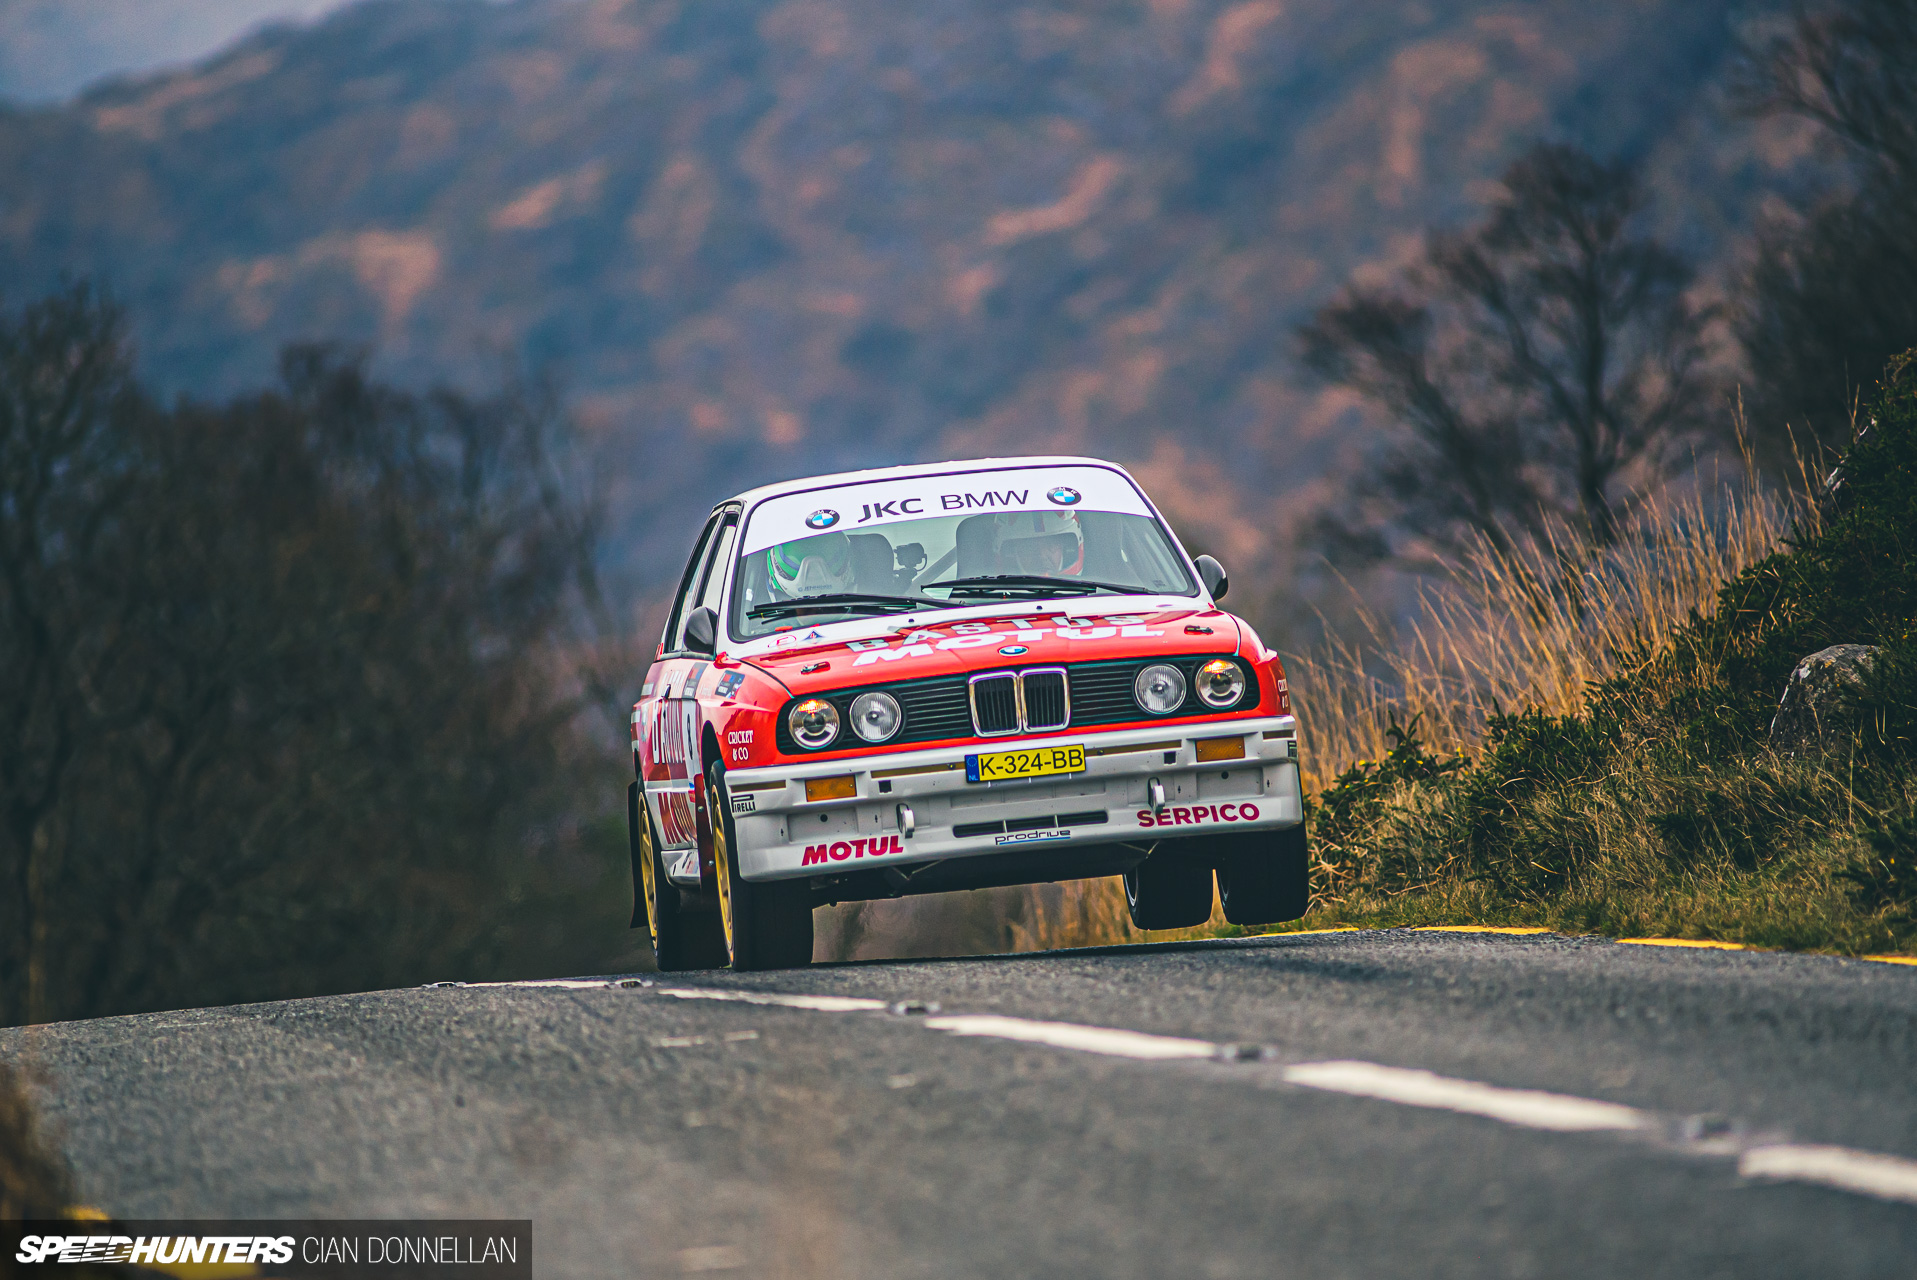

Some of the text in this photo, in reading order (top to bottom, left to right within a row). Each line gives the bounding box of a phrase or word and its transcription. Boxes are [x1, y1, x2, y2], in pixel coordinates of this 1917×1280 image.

[858, 490, 1029, 523] JKC BMW
[852, 625, 1165, 666] MOTUL
[728, 730, 754, 744] CRICKET
[738, 746, 749, 760] CO
[980, 749, 1083, 776] K-324-BB
[731, 794, 756, 813] PIRELLI
[1137, 803, 1260, 827] SERPICO
[995, 830, 1071, 845] prodrive
[802, 835, 904, 866] MOTUL
